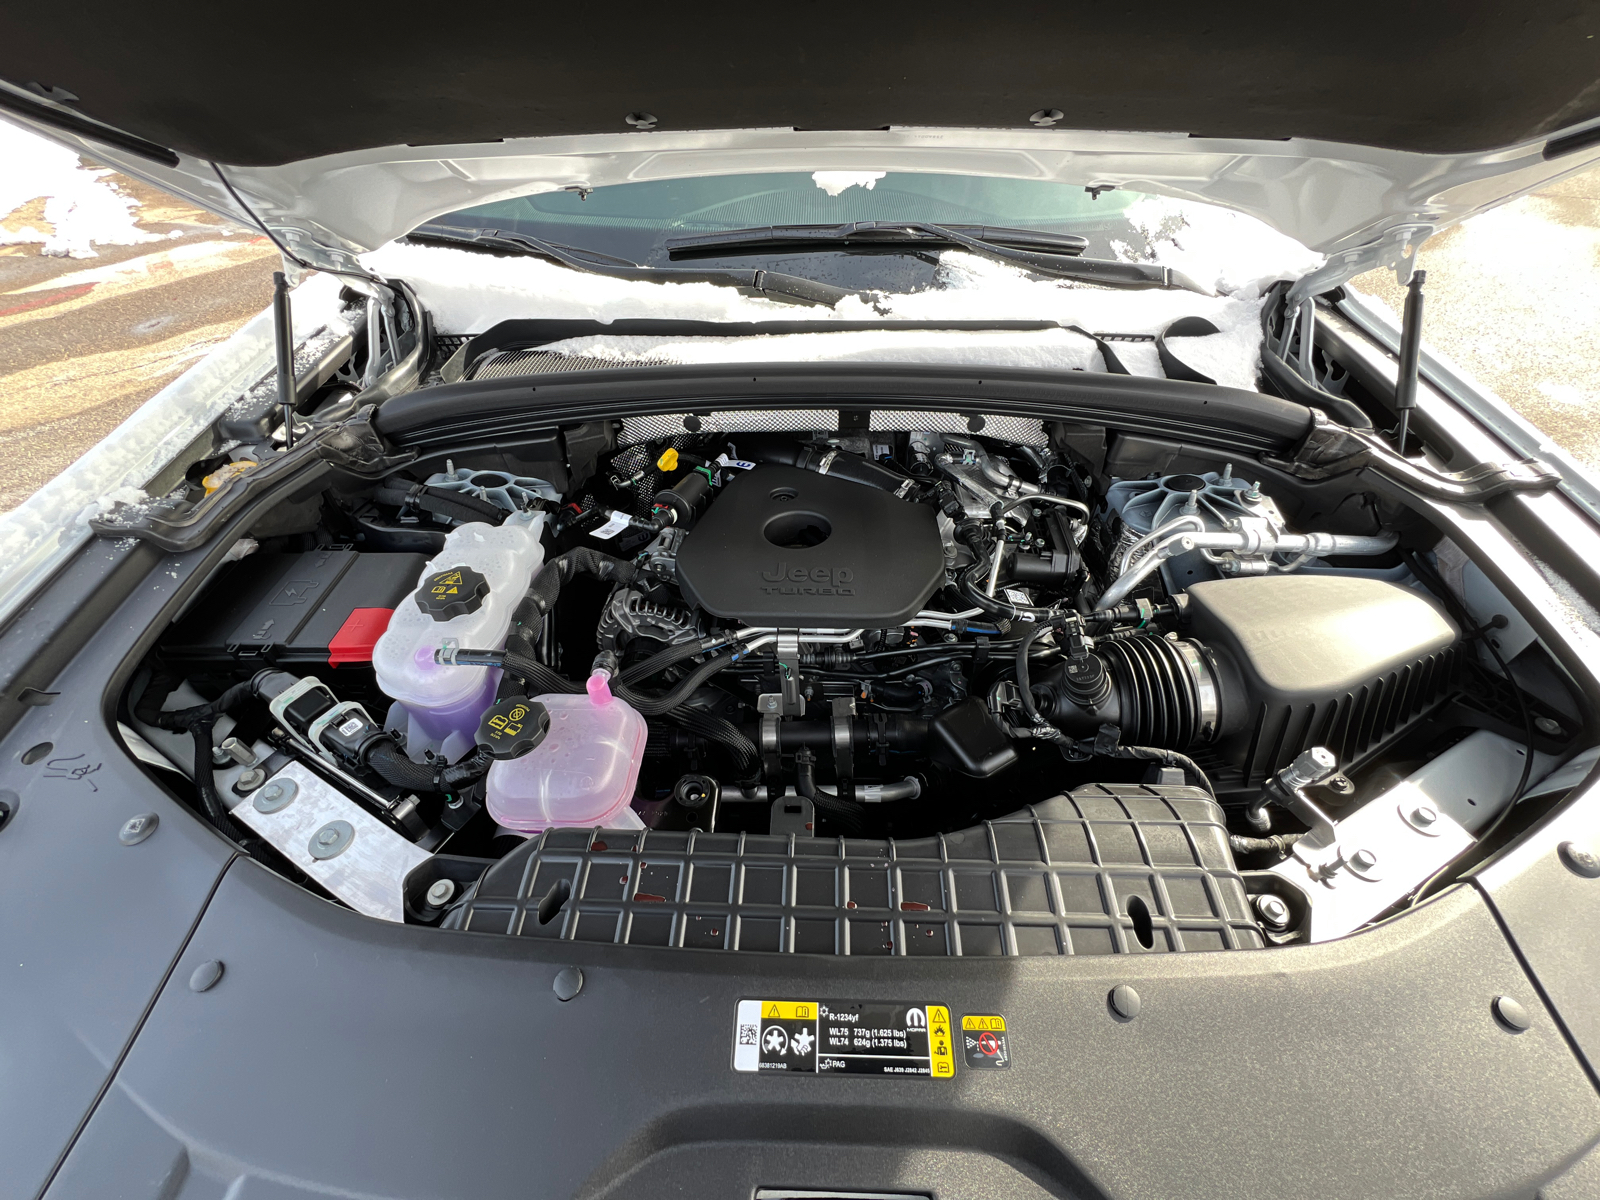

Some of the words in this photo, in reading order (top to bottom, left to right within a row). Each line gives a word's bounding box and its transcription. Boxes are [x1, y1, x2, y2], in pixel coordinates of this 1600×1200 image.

[762, 562, 854, 588] Jeep
[761, 586, 856, 596] TURBO
[829, 1013, 859, 1023] R-1234yf
[829, 1027, 849, 1036] WL75
[853, 1028, 870, 1038] 737g
[871, 1028, 892, 1038] (1.625
[893, 1029, 906, 1039] lbs)
[829, 1037, 849, 1046] WL74
[853, 1038, 870, 1048] 624g
[871, 1038, 892, 1048] (1.375
[893, 1039, 907, 1049] lbs)
[832, 1060, 846, 1068] PAG
